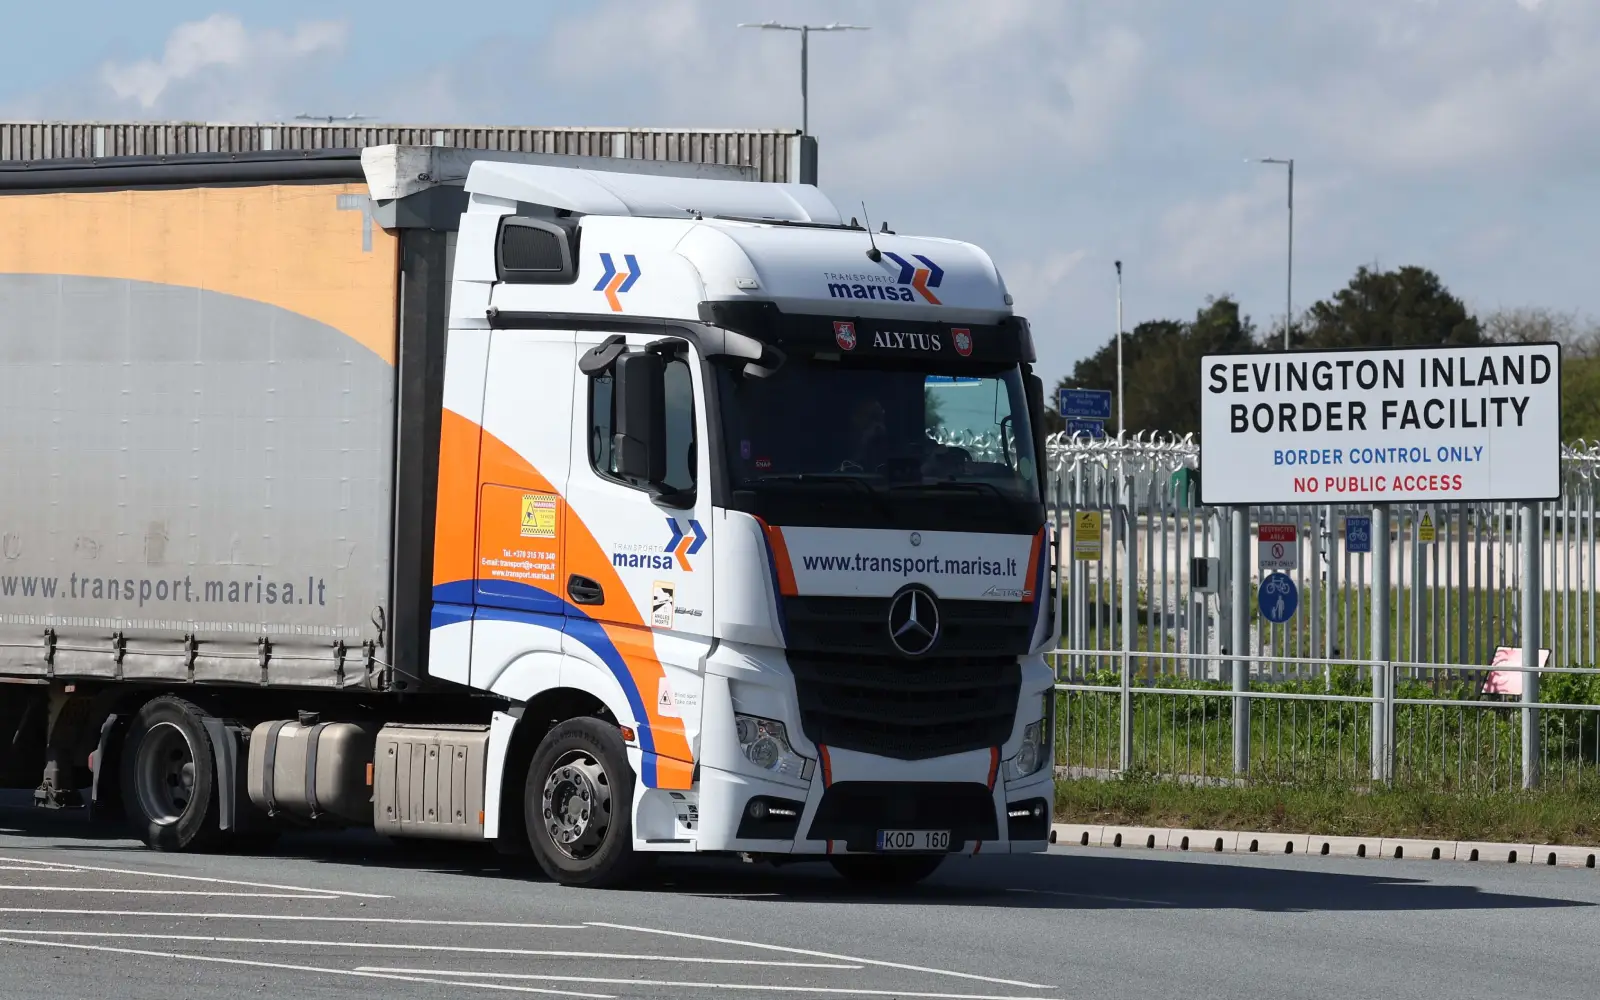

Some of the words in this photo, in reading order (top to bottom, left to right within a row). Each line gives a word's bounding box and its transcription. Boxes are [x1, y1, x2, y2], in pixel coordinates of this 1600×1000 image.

[823, 272, 895, 284] TRANSPORTO
[827, 282, 915, 302] marisa
[873, 331, 942, 351] ALYTUS
[1208, 358, 1404, 394] SEVINGTON
[1420, 354, 1551, 388] INLAND
[1230, 401, 1367, 433] BORDER
[1382, 396, 1530, 430] FACILITY
[1274, 449, 1343, 466] BORDER
[1350, 447, 1431, 464] CONTROL
[1437, 446, 1484, 462] ONLY
[1294, 477, 1319, 493] NO
[1325, 476, 1386, 493] PUBLIC
[1392, 474, 1463, 492] ACCESS
[545, 552, 556, 560] 340
[613, 542, 664, 553] TRANSPORTO
[612, 552, 673, 570] marisa
[803, 553, 1017, 577] www.transport.marisa.lt
[1, 572, 326, 607] www.transport.marisa.lt
[885, 832, 915, 848] KOD
[925, 832, 948, 848] 160
